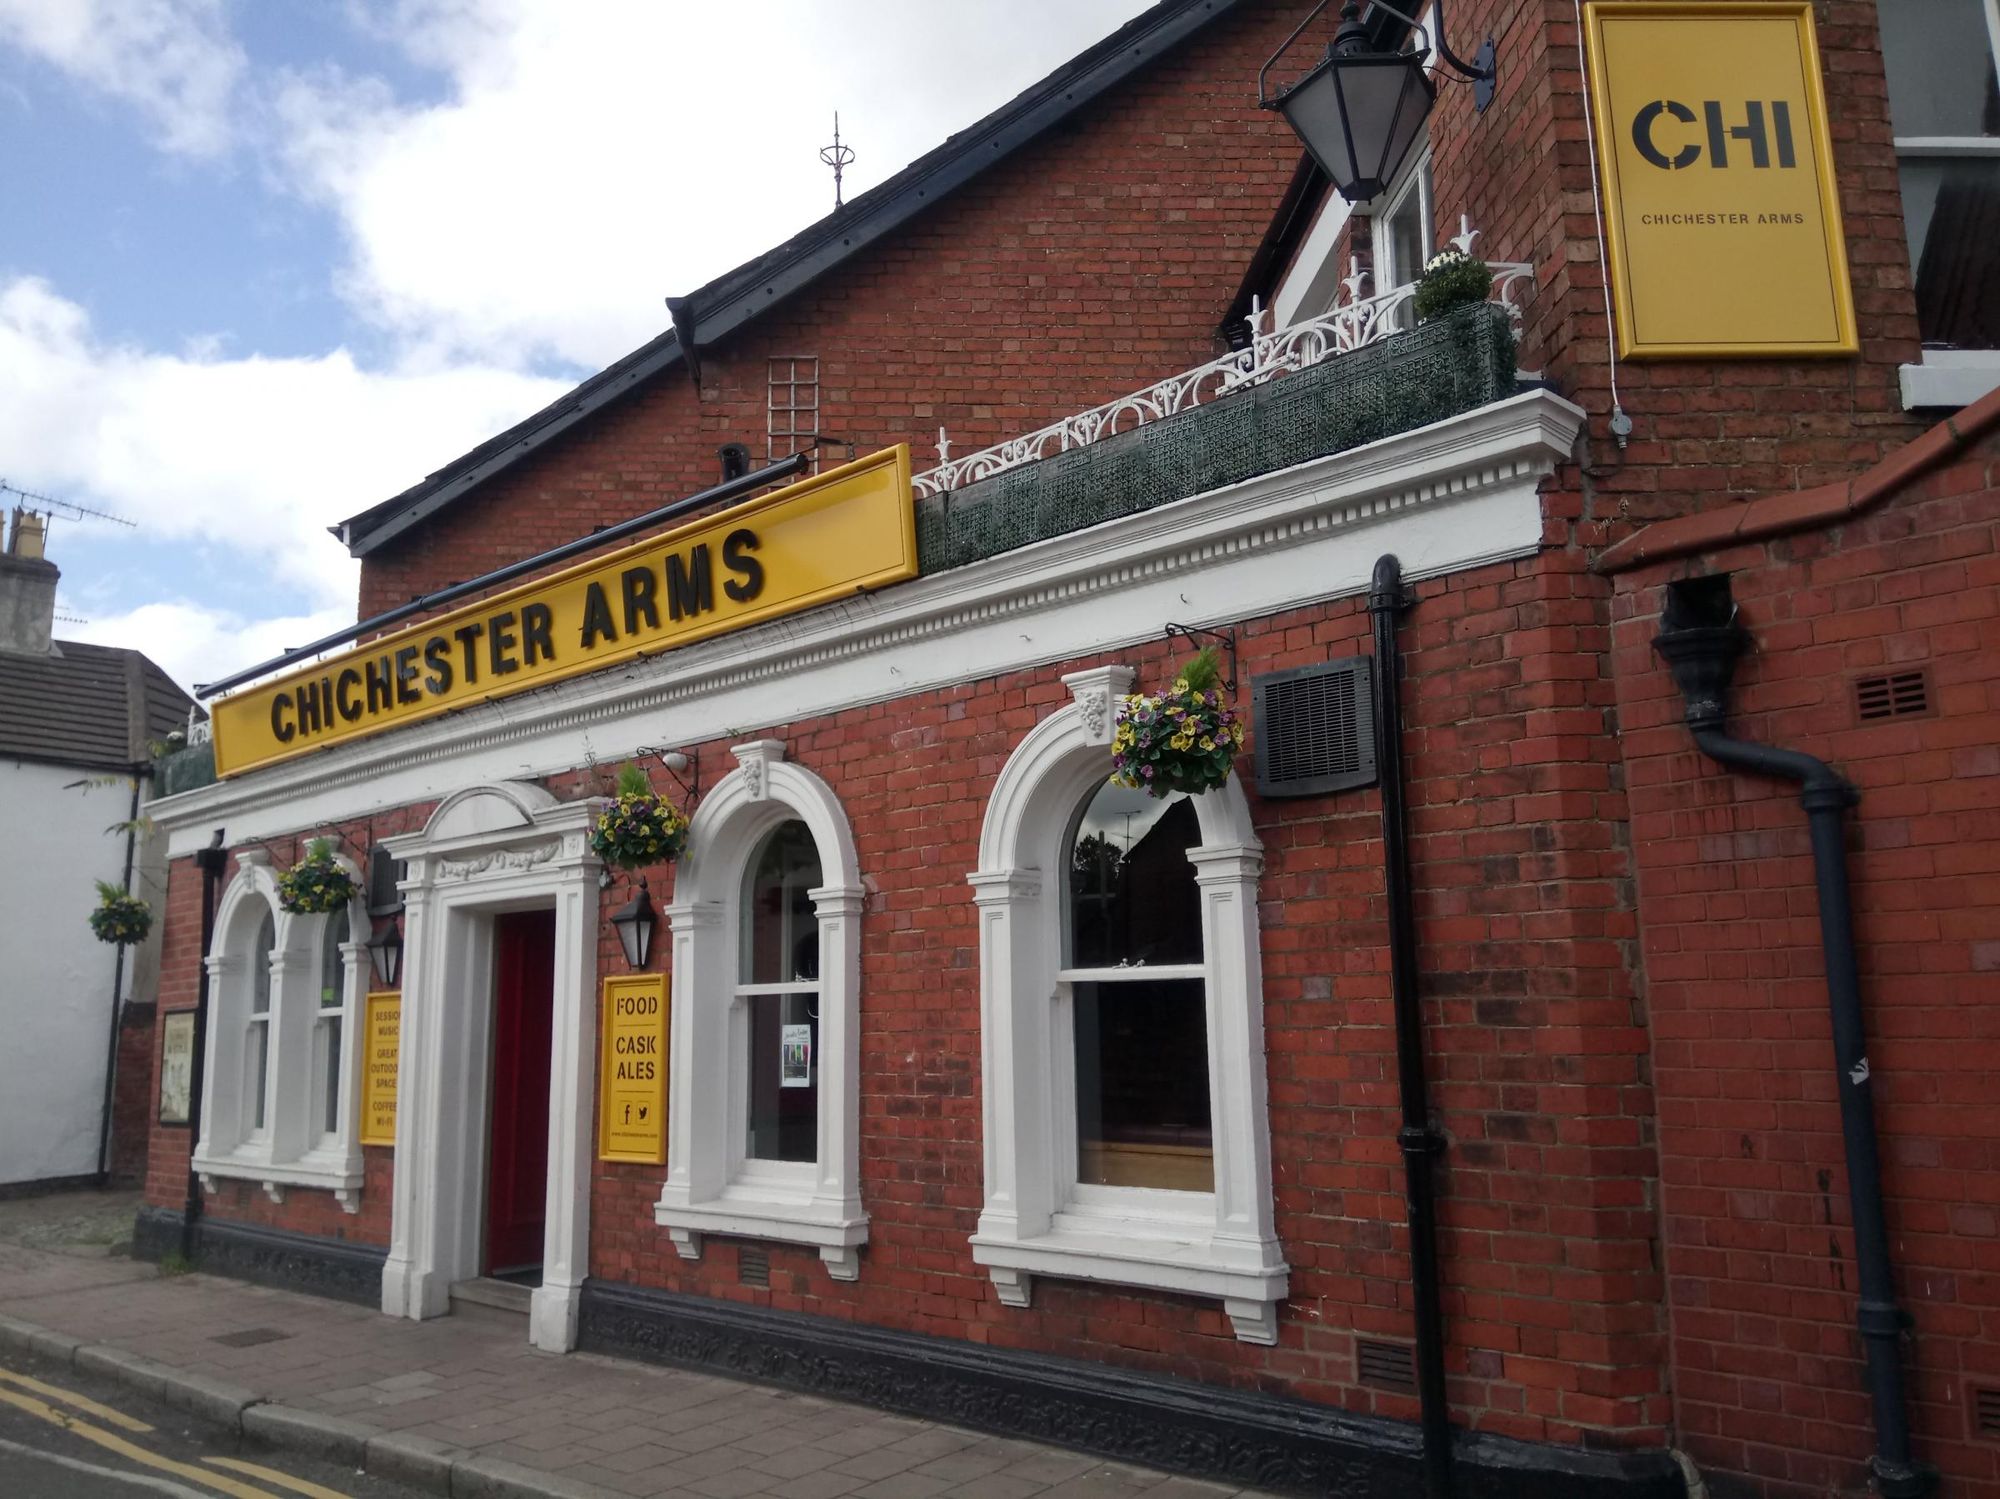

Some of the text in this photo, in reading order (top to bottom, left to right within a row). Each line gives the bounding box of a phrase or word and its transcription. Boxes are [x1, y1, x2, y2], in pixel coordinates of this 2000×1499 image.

[1632, 100, 1796, 170] CHI
[1641, 213, 1804, 225] CHICHESTER ARMS
[270, 529, 764, 742] CHICHESTER ARMS
[617, 997, 657, 1016] FOOD
[378, 1026, 399, 1036] MUSIC
[616, 1036, 656, 1054] CASK
[377, 1048, 398, 1059] GREAT
[371, 1064, 398, 1074] OUTDOO
[617, 1061, 655, 1080] ALES
[376, 1078, 397, 1089] SPACE
[373, 1101, 397, 1112] COFFEE
